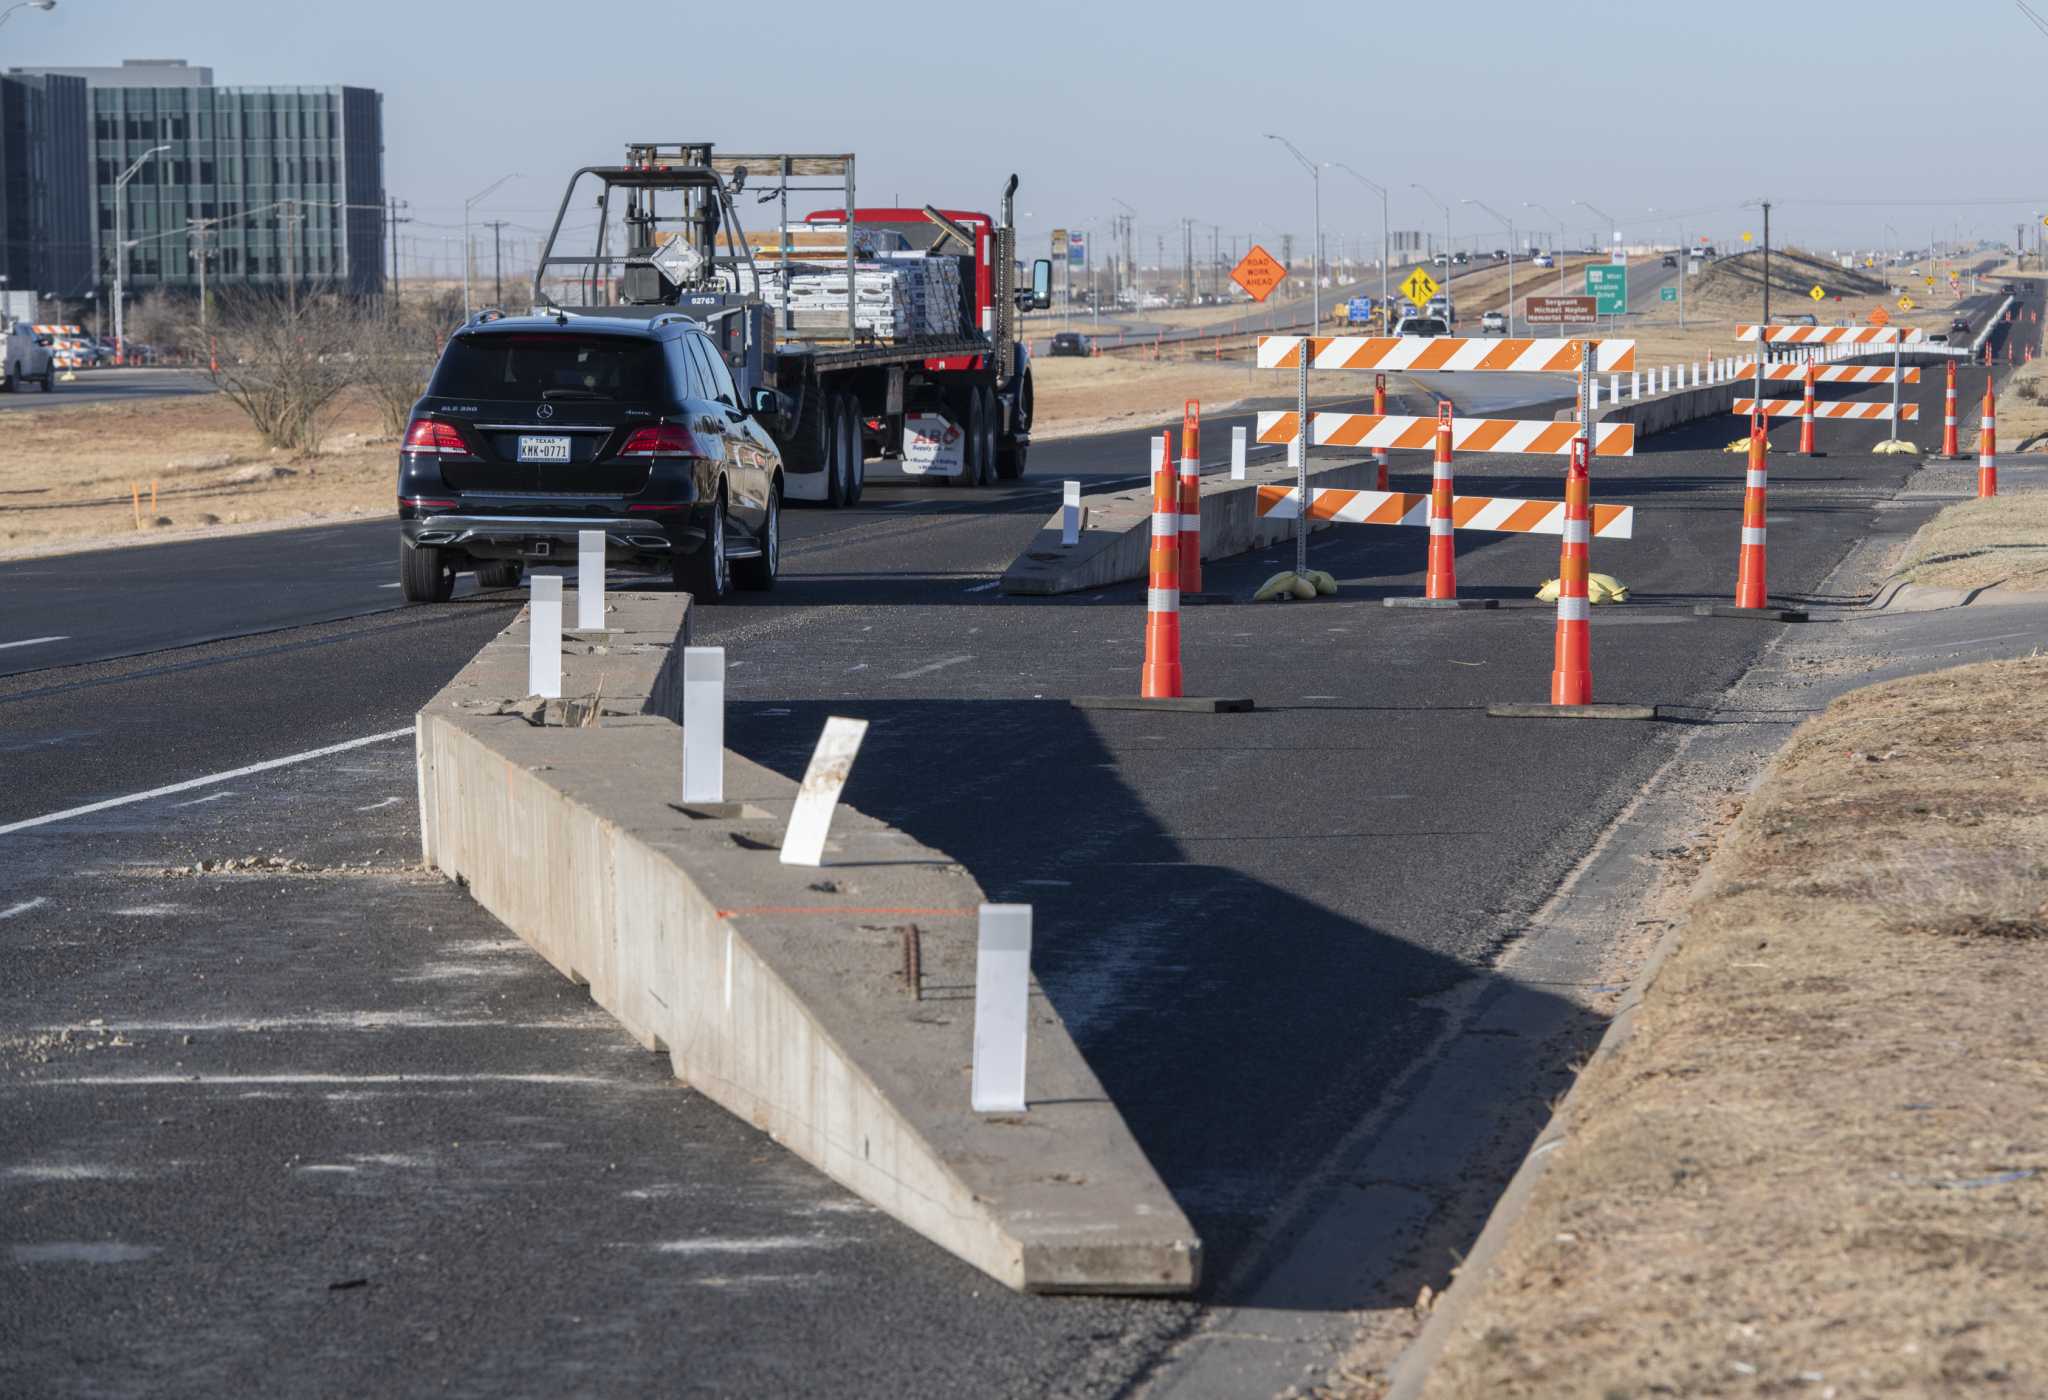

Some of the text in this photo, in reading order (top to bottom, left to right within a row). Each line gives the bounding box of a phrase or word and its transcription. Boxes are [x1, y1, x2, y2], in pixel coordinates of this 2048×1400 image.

[1247, 278, 1273, 286] AHEAD
[1545, 299, 1578, 307] Sergeant
[912, 428, 958, 445] ABC
